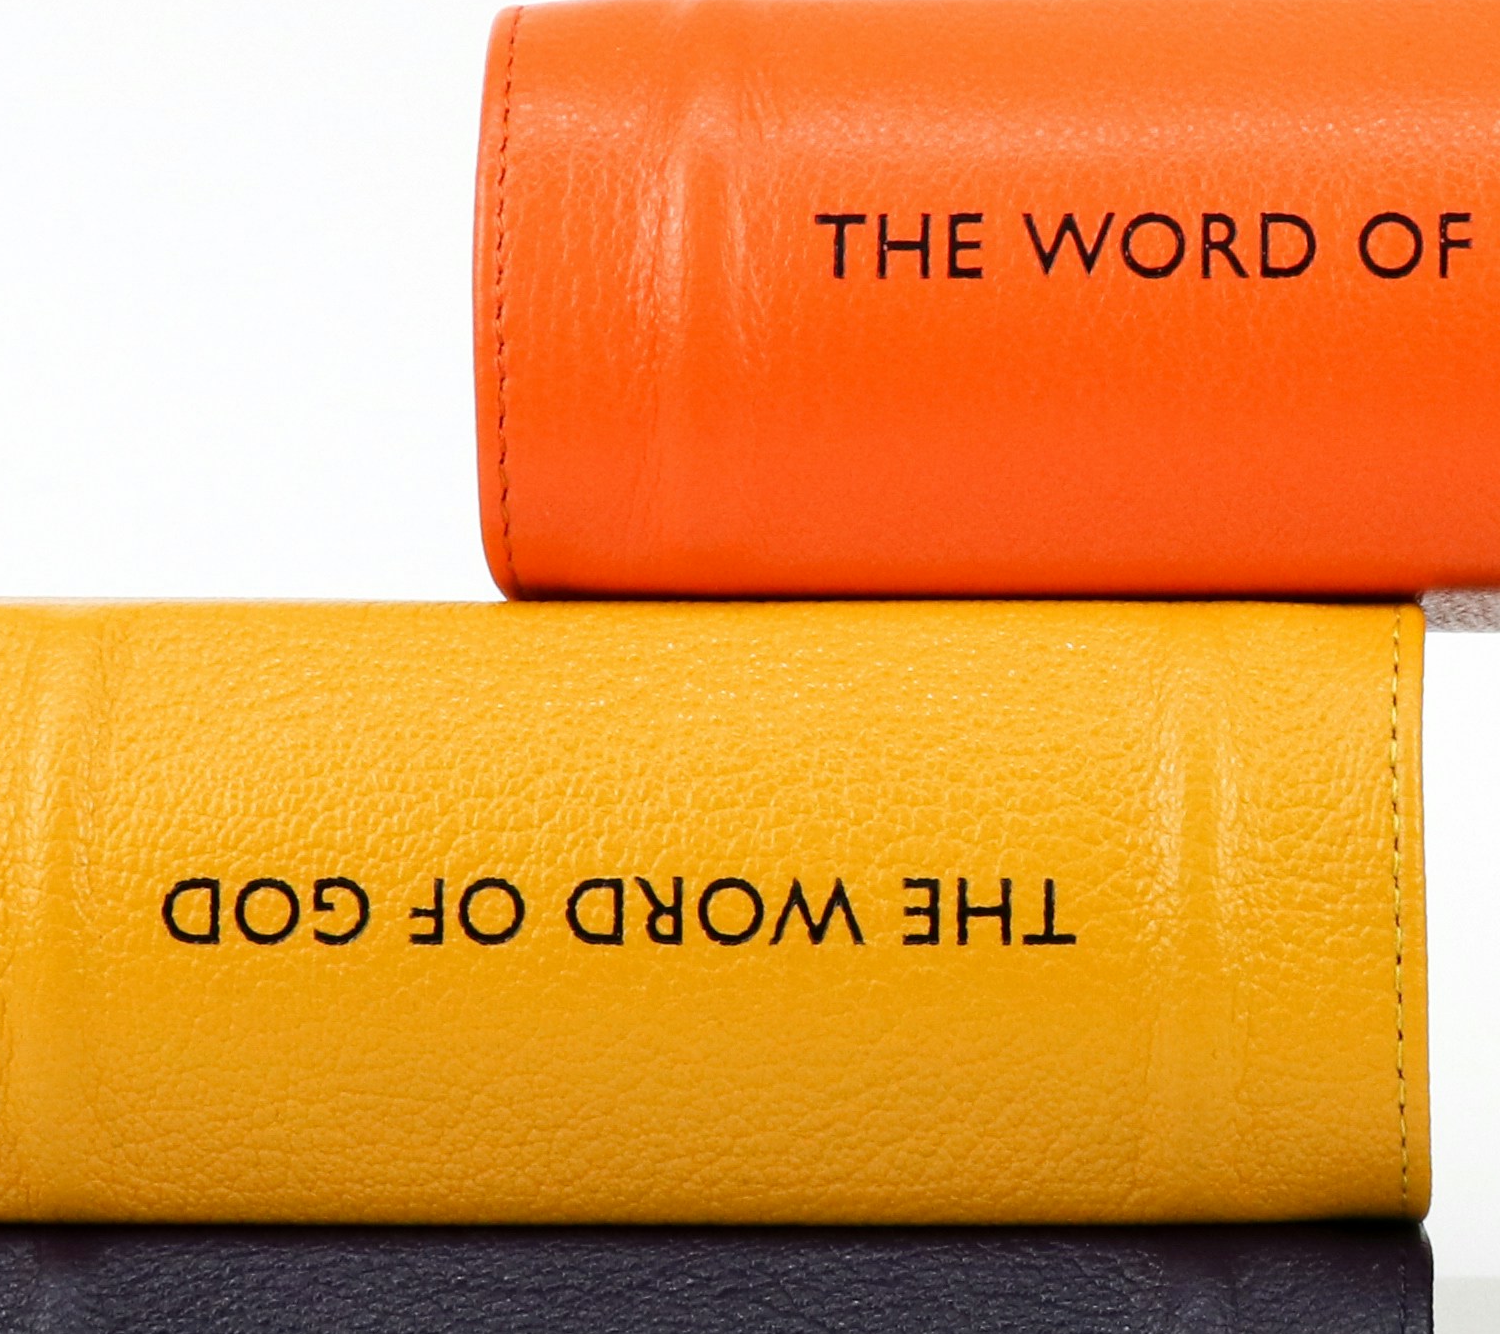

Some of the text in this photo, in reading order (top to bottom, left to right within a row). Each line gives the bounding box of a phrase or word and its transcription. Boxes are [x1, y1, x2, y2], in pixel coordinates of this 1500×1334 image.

[818, 213, 982, 279] THE
[1025, 213, 1316, 279] WORD
[1360, 212, 1470, 279] OF
[162, 876, 1077, 946] THE WORD OF GOD
